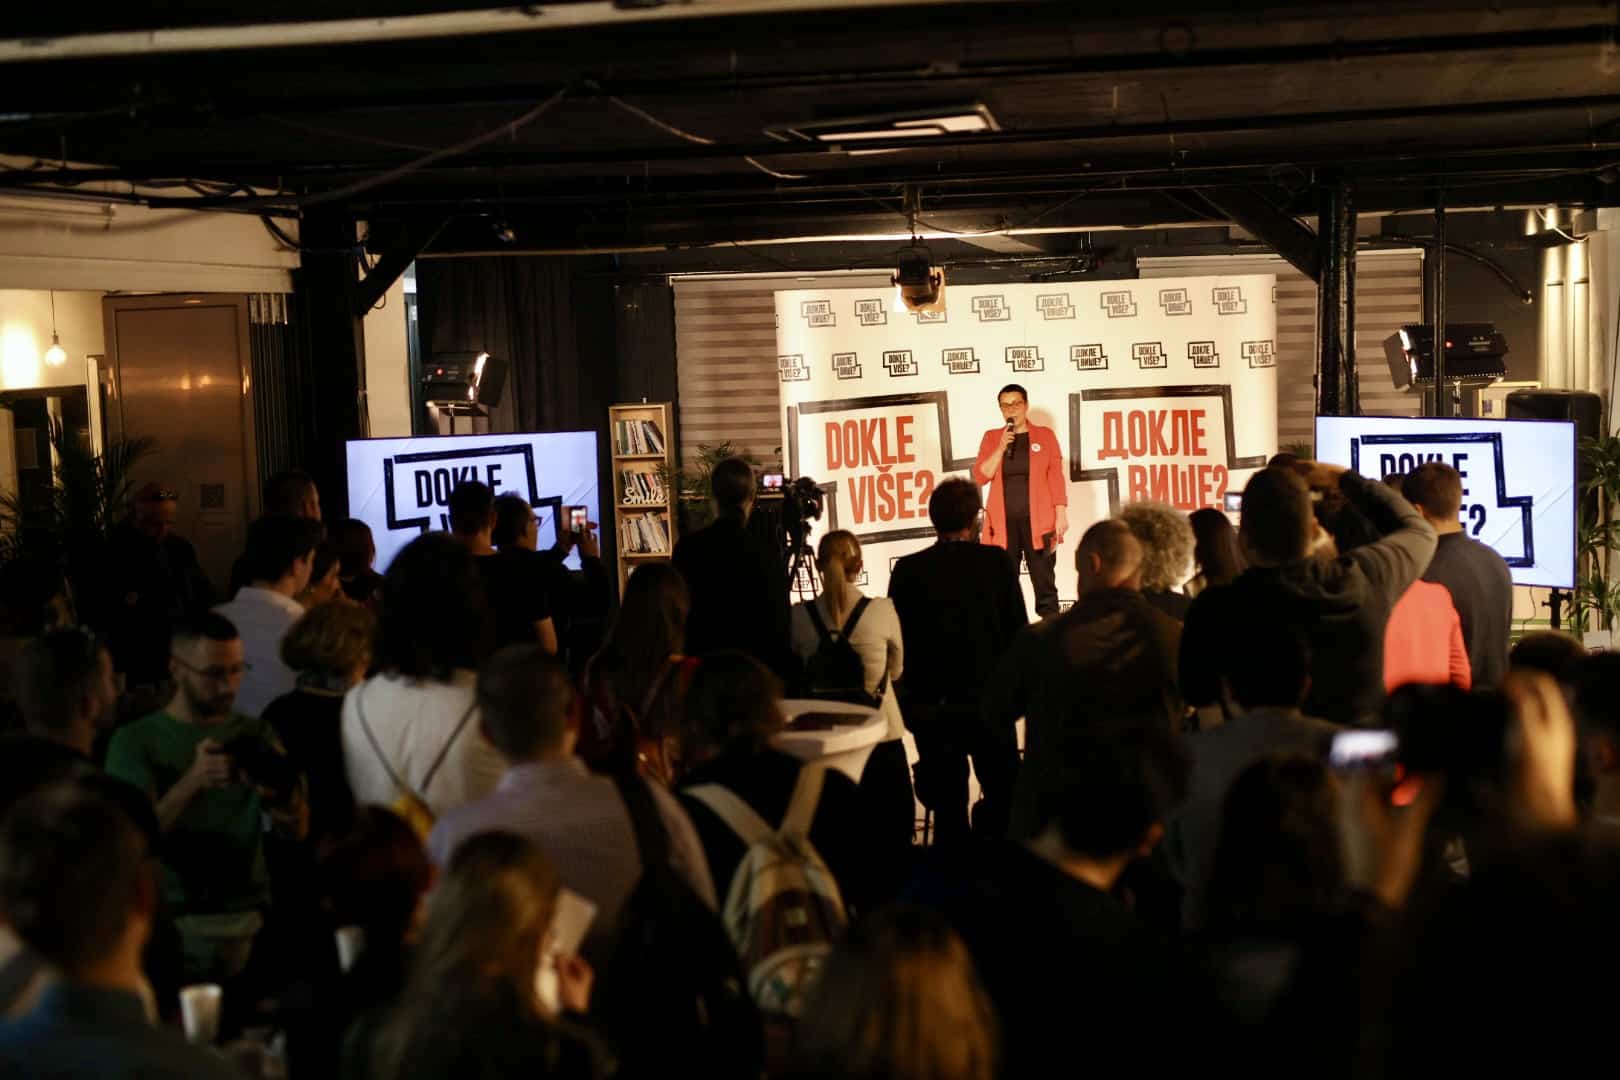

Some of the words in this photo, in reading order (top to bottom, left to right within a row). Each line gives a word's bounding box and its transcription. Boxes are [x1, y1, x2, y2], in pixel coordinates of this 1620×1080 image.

[1012, 349, 1032, 359] DOKLE
[825, 415, 915, 470] DOKLE
[1098, 409, 1207, 460] ДОКЛЕ
[623, 487, 666, 504] Smile
[848, 464, 935, 524] VIŠE?
[1128, 464, 1228, 512] ВИШЕ?
